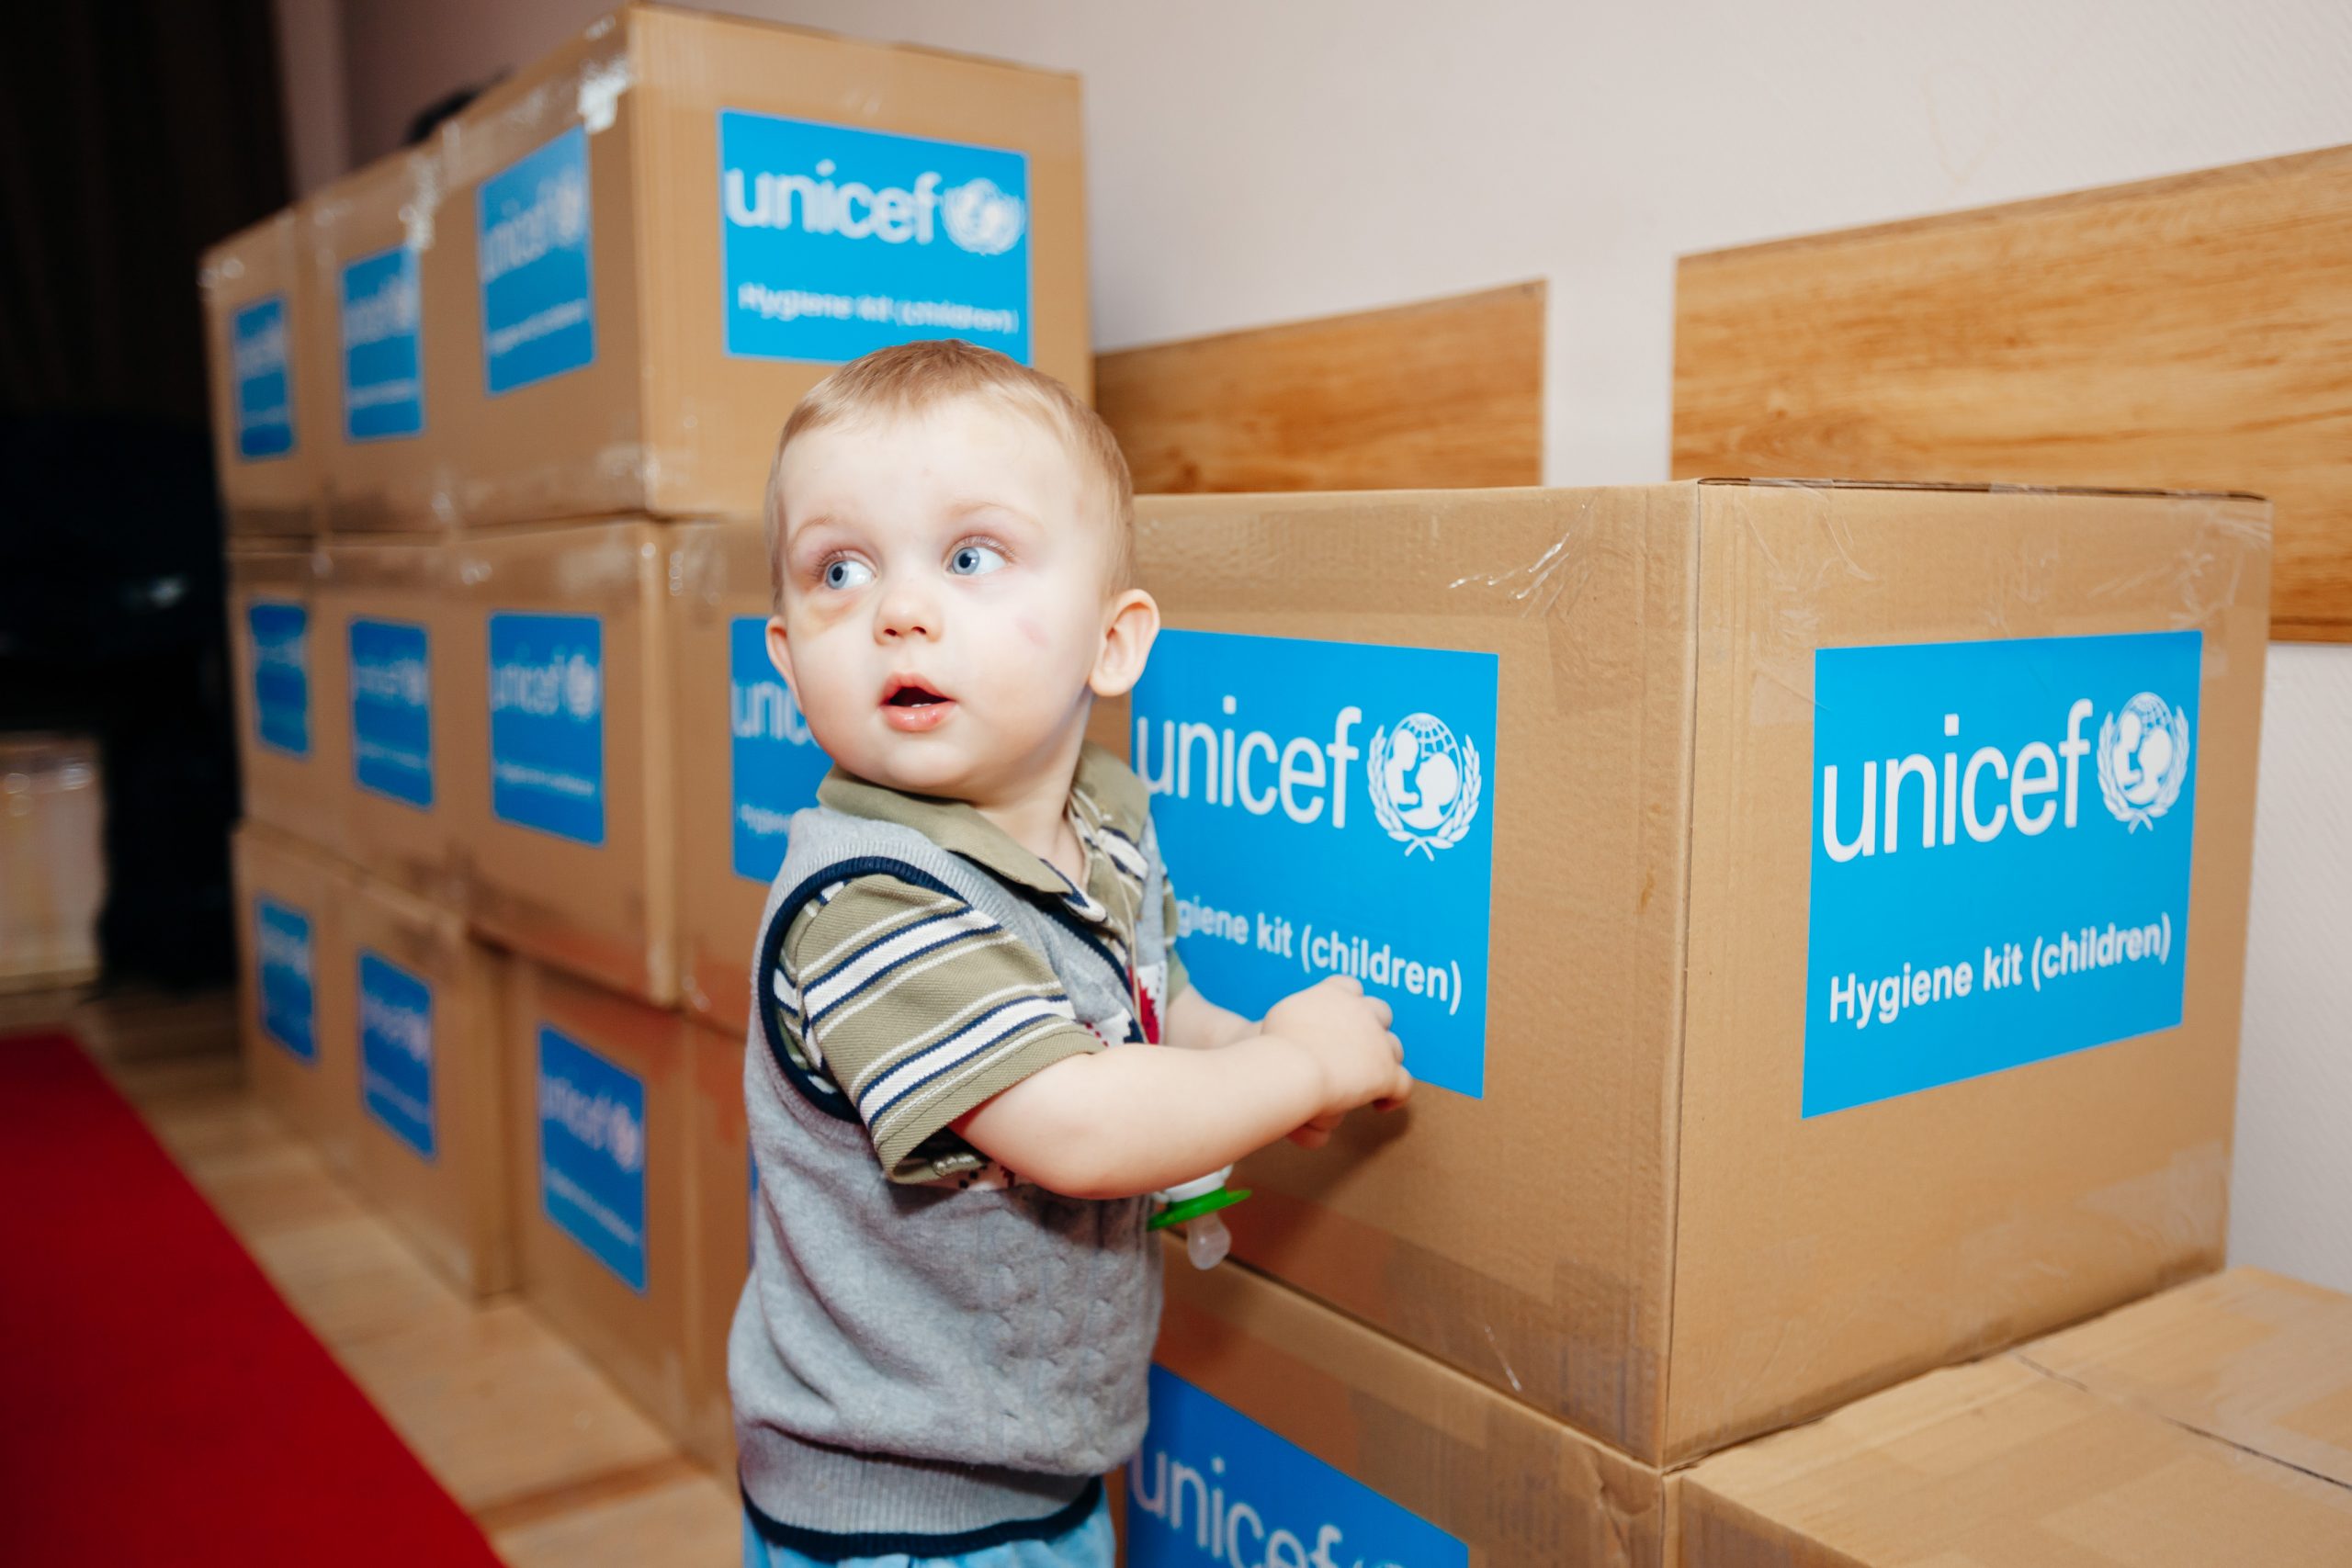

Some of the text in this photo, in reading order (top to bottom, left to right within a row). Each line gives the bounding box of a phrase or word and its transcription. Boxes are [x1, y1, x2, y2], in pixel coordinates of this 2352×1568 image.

[725, 159, 942, 244] unicef
[1137, 695, 1362, 829] unicef
[1823, 699, 2093, 863] unicef
[1176, 897, 1462, 1015] giene kit (children)
[1829, 912, 2171, 1030] Hygiene kit (children)
